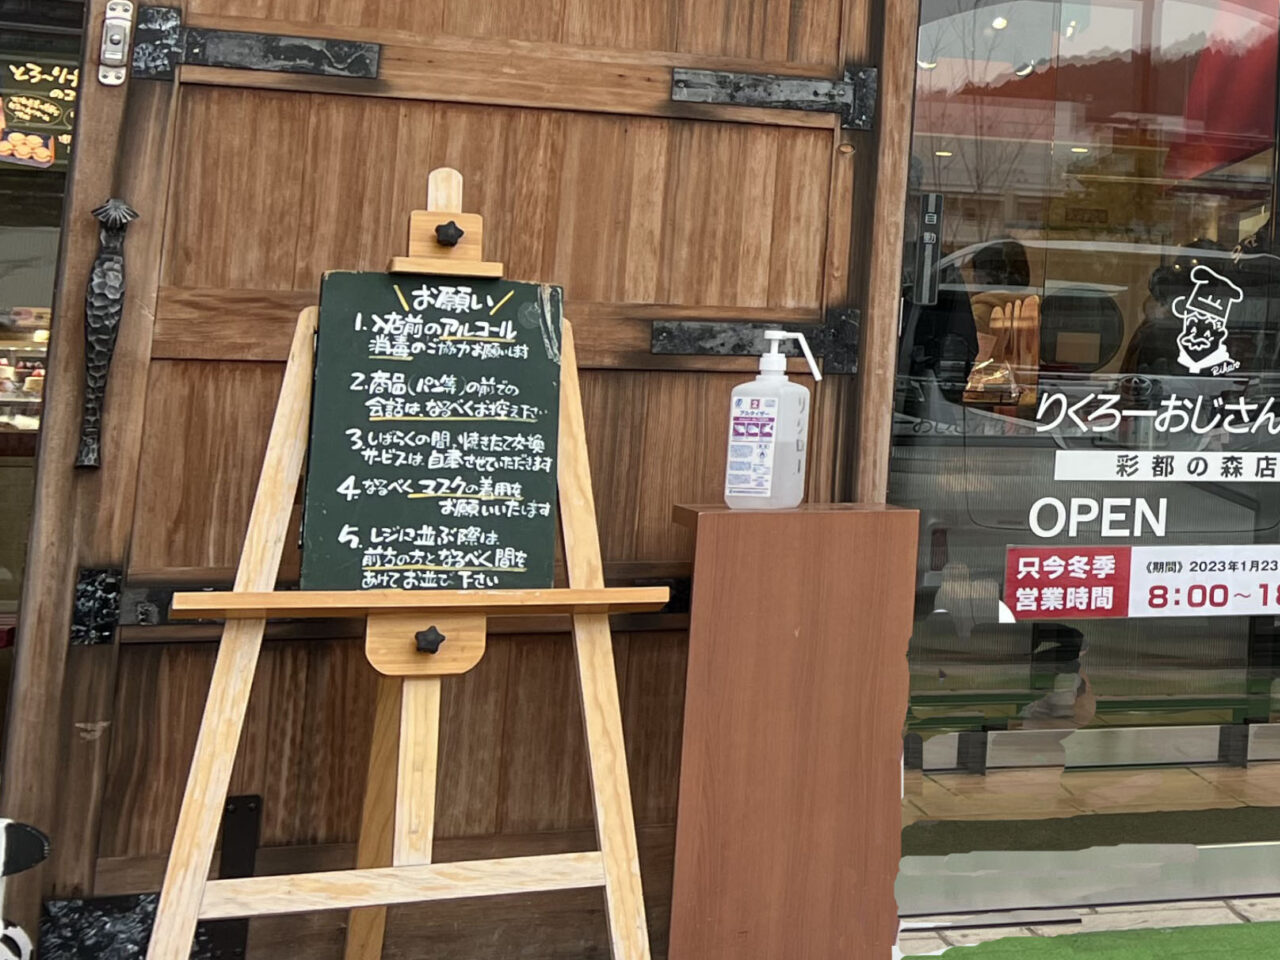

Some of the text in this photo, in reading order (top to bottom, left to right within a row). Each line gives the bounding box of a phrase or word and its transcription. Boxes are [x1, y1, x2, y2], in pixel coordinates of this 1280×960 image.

[922, 213, 937, 244] 自動
[412, 284, 494, 313] お願い
[368, 334, 529, 360] 消毒のご協力お願いします
[1116, 454, 1277, 479] 彩都の森店
[439, 499, 551, 518] お願いいたします
[1028, 497, 1168, 538] OPEN
[362, 546, 528, 570] 前方の方となるべく間を
[1016, 555, 1116, 581] 只今冬季
[362, 571, 499, 589] あけてお並び下さい
[1015, 586, 1114, 611] 営業時間
